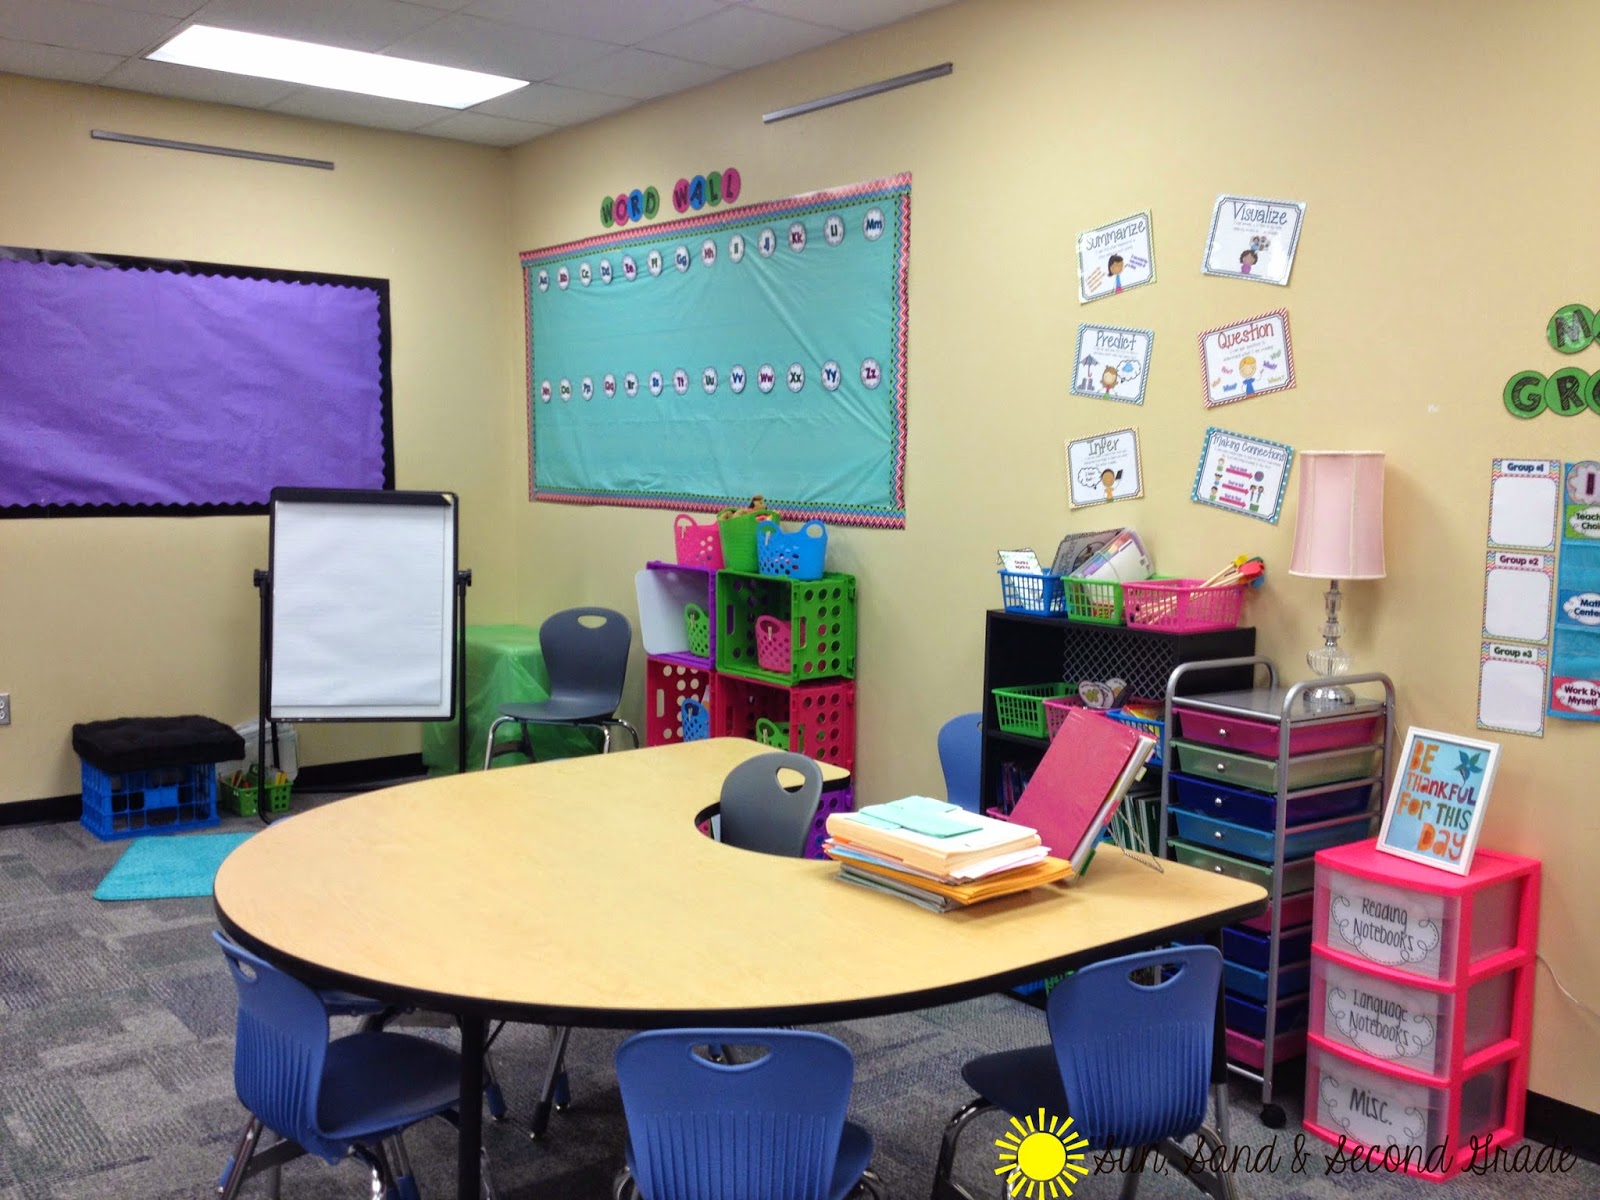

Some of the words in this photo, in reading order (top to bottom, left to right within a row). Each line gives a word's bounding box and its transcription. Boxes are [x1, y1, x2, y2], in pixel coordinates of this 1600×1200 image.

[601, 191, 656, 224] WORD
[674, 174, 734, 208] WALL
[1233, 201, 1287, 225] Visualize
[1086, 220, 1146, 250] Summarize
[1096, 330, 1136, 350] Predict
[1218, 323, 1274, 349] Question
[1555, 308, 1600, 348] M
[1511, 375, 1600, 412] GR
[1087, 437, 1120, 456] Infer
[1212, 436, 1240, 452] Making
[1242, 441, 1286, 462] Connections
[1507, 463, 1534, 473] Group
[1500, 555, 1527, 566] Group
[1494, 646, 1521, 658] Group
[1564, 685, 1588, 696] Work
[1568, 695, 1598, 706] Myself
[1410, 740, 1440, 774] BE
[1436, 802, 1472, 831] THIS
[1362, 898, 1408, 934] Reading
[1354, 918, 1414, 952] Notebooks
[1353, 988, 1408, 1026] Language
[1349, 1010, 1410, 1046] Notebooks
